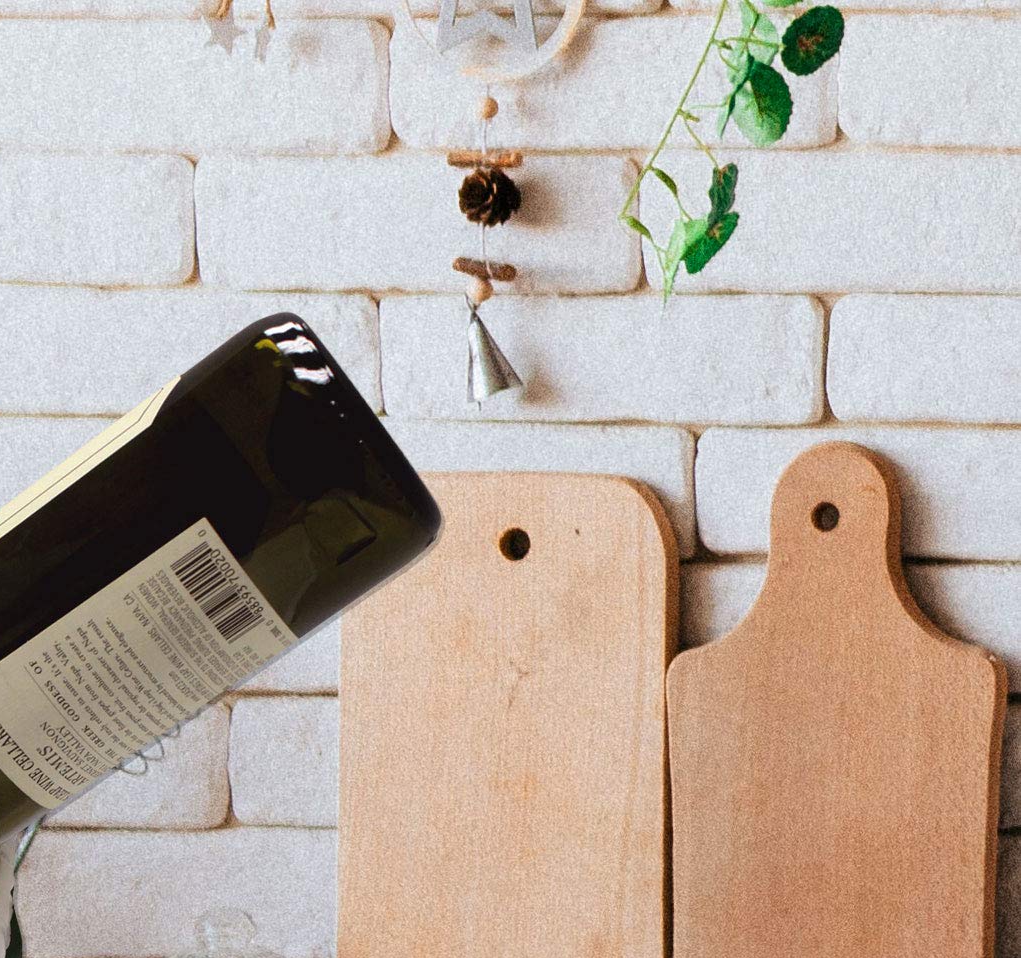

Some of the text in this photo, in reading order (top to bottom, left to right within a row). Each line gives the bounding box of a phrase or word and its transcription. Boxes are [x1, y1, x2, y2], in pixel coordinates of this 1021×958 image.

[197, 528, 207, 538] 0
[210, 548, 239, 584] 70020
[137, 582, 159, 609] WOMEN
[146, 575, 171, 606] BECAUSE
[155, 569, 185, 606] BEVERAGES
[122, 592, 135, 606] CA
[236, 584, 264, 615] 88593
[86, 618, 104, 639] result
[168, 605, 197, 639] PREGNANCY
[180, 603, 208, 634] ALCOHOLIC
[76, 625, 92, 648] Napa
[105, 617, 128, 648] elegance.
[53, 640, 69, 667] Valley.
[69, 641, 86, 662] create
[86, 646, 99, 655] of
[102, 638, 114, 655] The
[123, 646, 139, 660] and
[28, 660, 42, 675] OF
[42, 651, 53, 664] the
[84, 662, 93, 671] to
[167, 652, 185, 670] WINE
[51, 663, 62, 677] It's
[70, 665, 85, 685] Napa
[97, 656, 121, 684] character
[136, 659, 158, 684] structure
[62, 676, 79, 697] name.
[84, 683, 99, 701] from
[91, 670, 114, 697] combine
[131, 676, 144, 693] Wine
[44, 680, 80, 722] GODDESS
[77, 696, 86, 706] its
[117, 683, 140, 706] regional
[84, 705, 102, 725] reflects
[97, 700, 116, 717] grapes
[39, 721, 85, 766] SAUVIGNON
[56, 725, 101, 767] NAPA VALLEY
[81, 724, 105, 748] GREEK
[104, 747, 118, 759] THE
[28, 767, 54, 791] WINE
